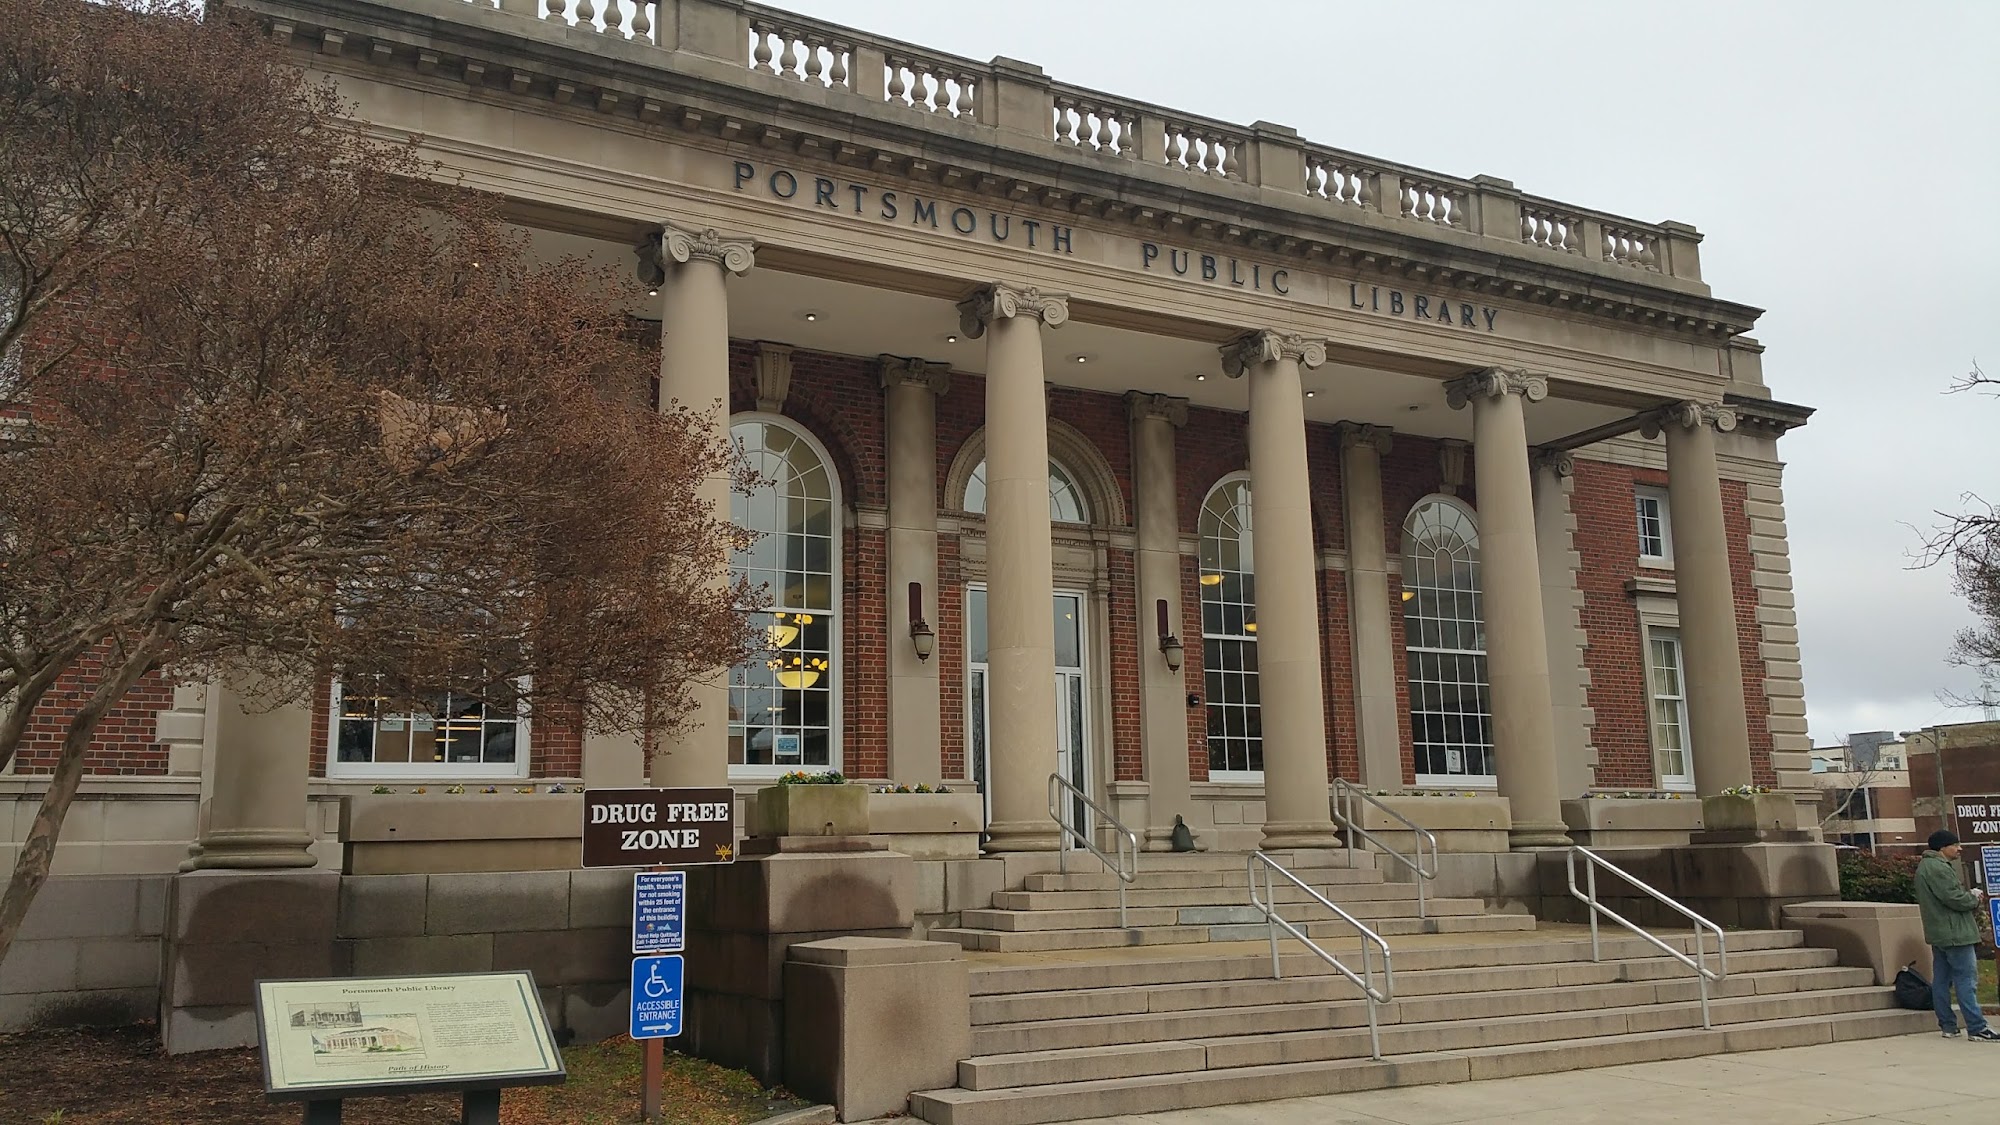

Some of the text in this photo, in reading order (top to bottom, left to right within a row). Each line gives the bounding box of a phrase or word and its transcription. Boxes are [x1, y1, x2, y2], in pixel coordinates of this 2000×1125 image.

[733, 159, 1500, 332] PORTSMOUTH PUBLIC LIBRARY
[590, 802, 729, 824] DRUG FREE
[1957, 804, 1986, 817] DRUG
[1972, 820, 2000, 834] ZON
[620, 829, 700, 850] ZONE
[636, 1000, 679, 1011] ACCESSIBLE
[639, 1010, 676, 1021] ENTRANCE
